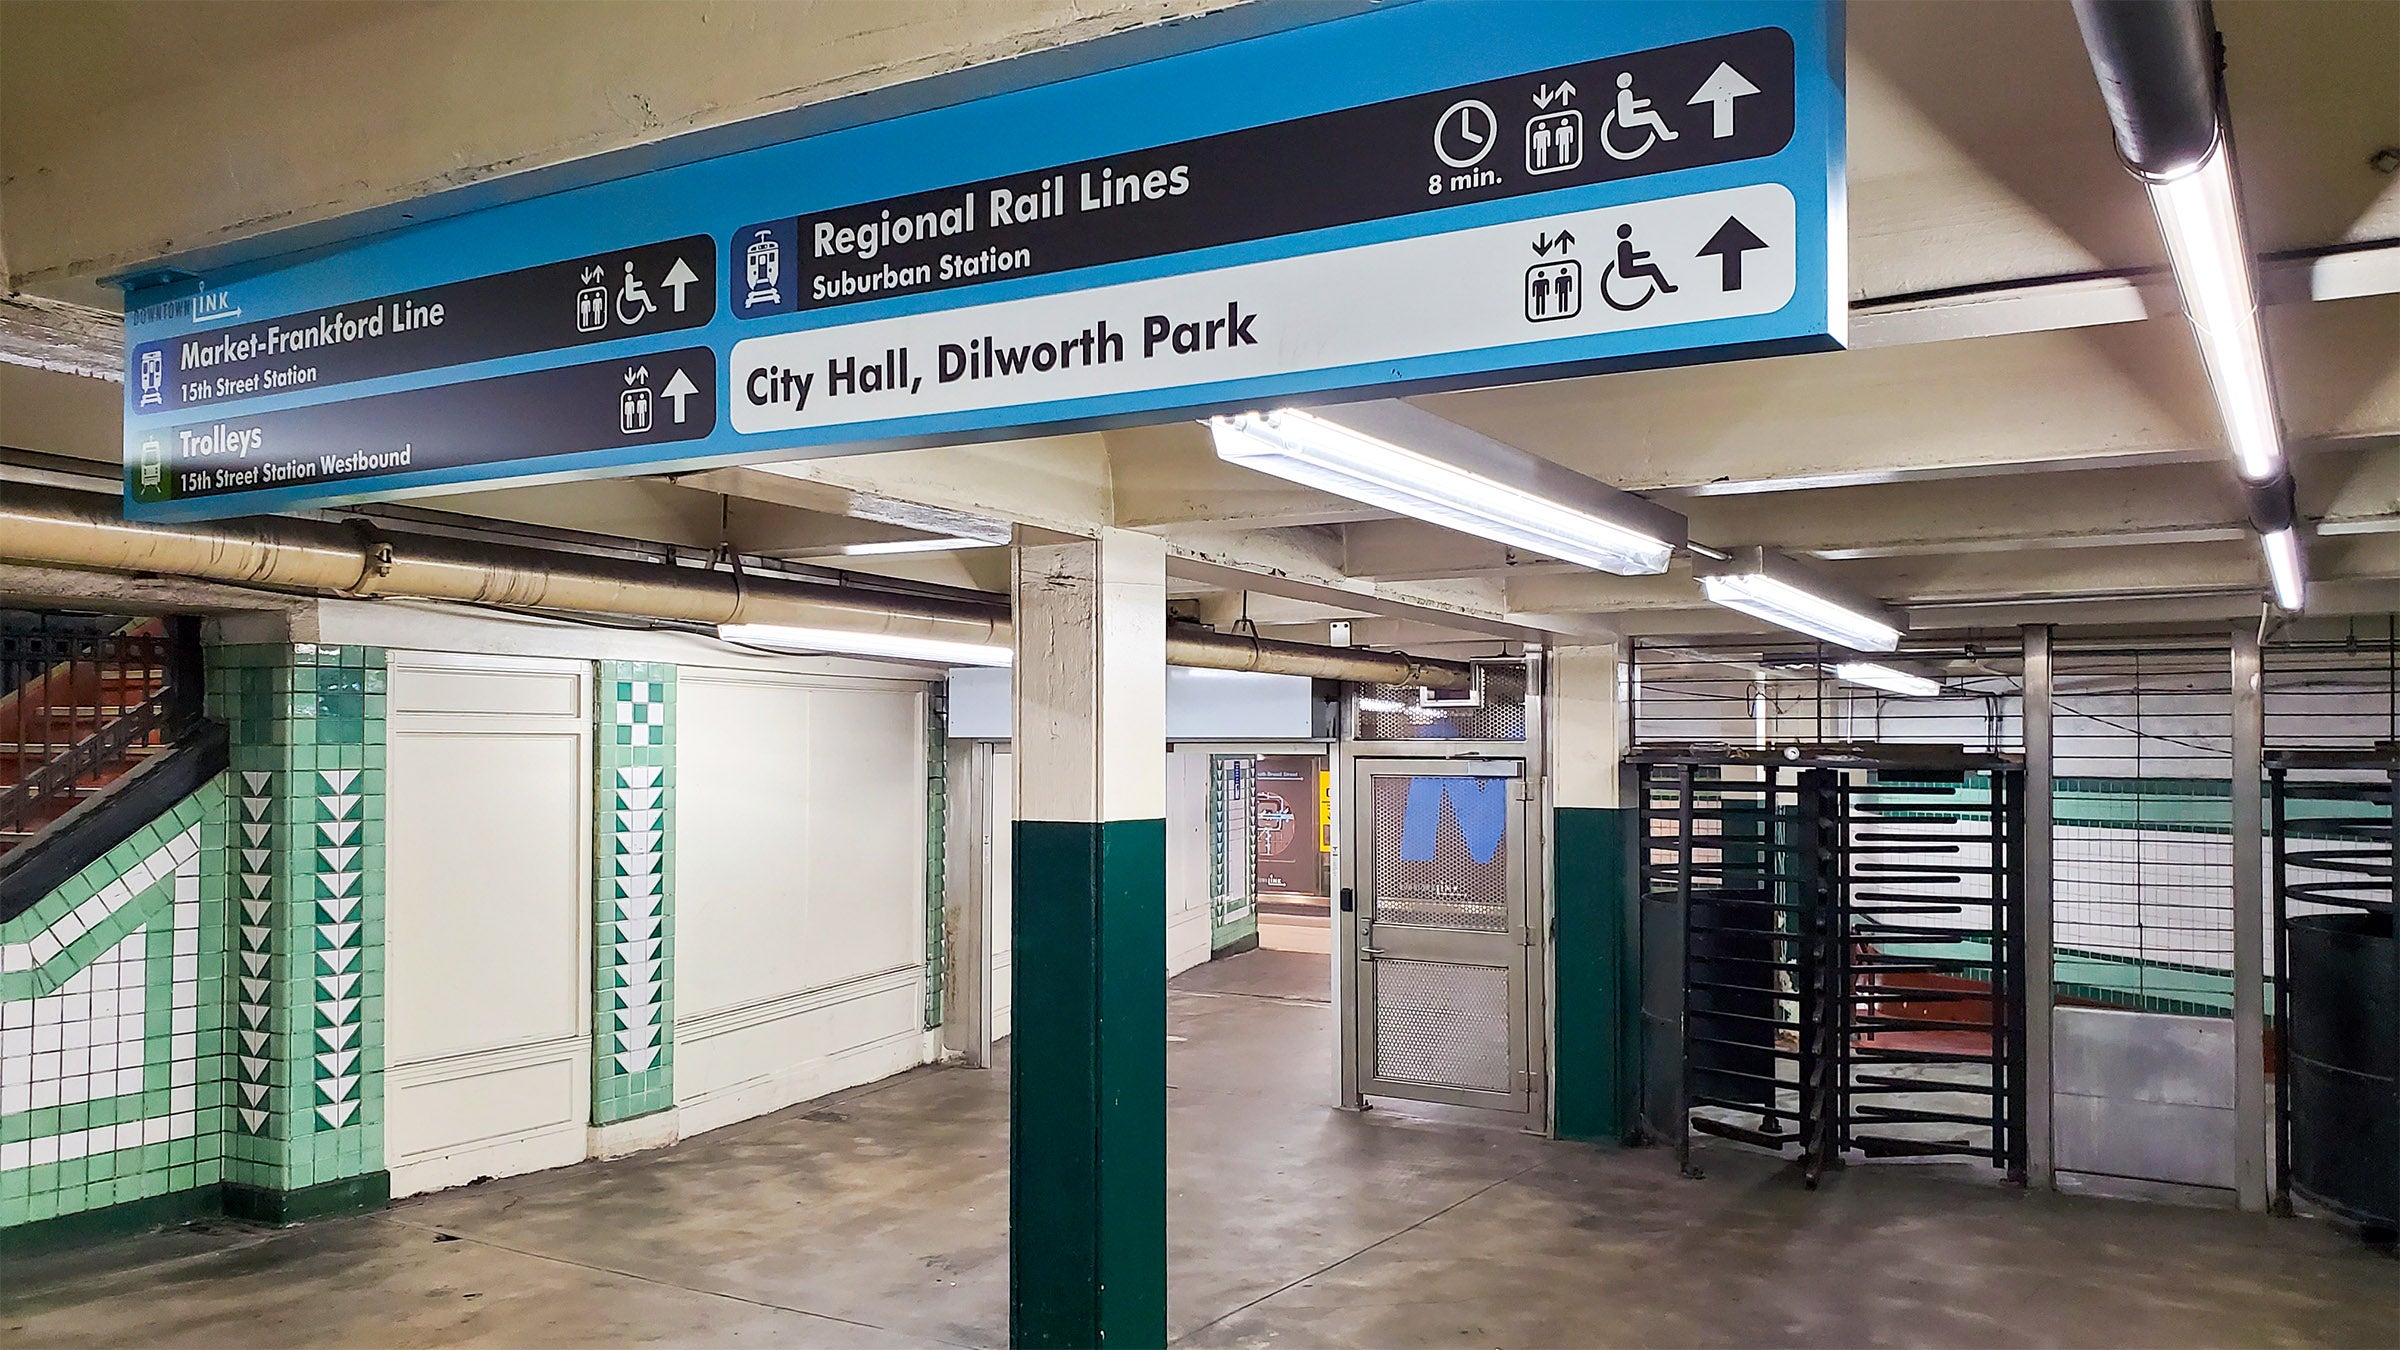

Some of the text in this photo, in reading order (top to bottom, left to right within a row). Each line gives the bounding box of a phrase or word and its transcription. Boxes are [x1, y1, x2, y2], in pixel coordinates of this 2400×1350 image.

[1428, 167, 1502, 195] 8 min.
[814, 164, 1190, 259] Regional Rail Lines
[812, 246, 1031, 301] Suburban Station
[133, 286, 236, 326] DOWNTOWN LINK
[180, 301, 445, 371] Market-Frankford Line
[746, 301, 1259, 412] City Hall, Dilworth Park
[180, 364, 317, 403] 15th Street Station
[180, 424, 262, 459] Trolleys
[180, 443, 411, 493] 15th Street Station Westbound
